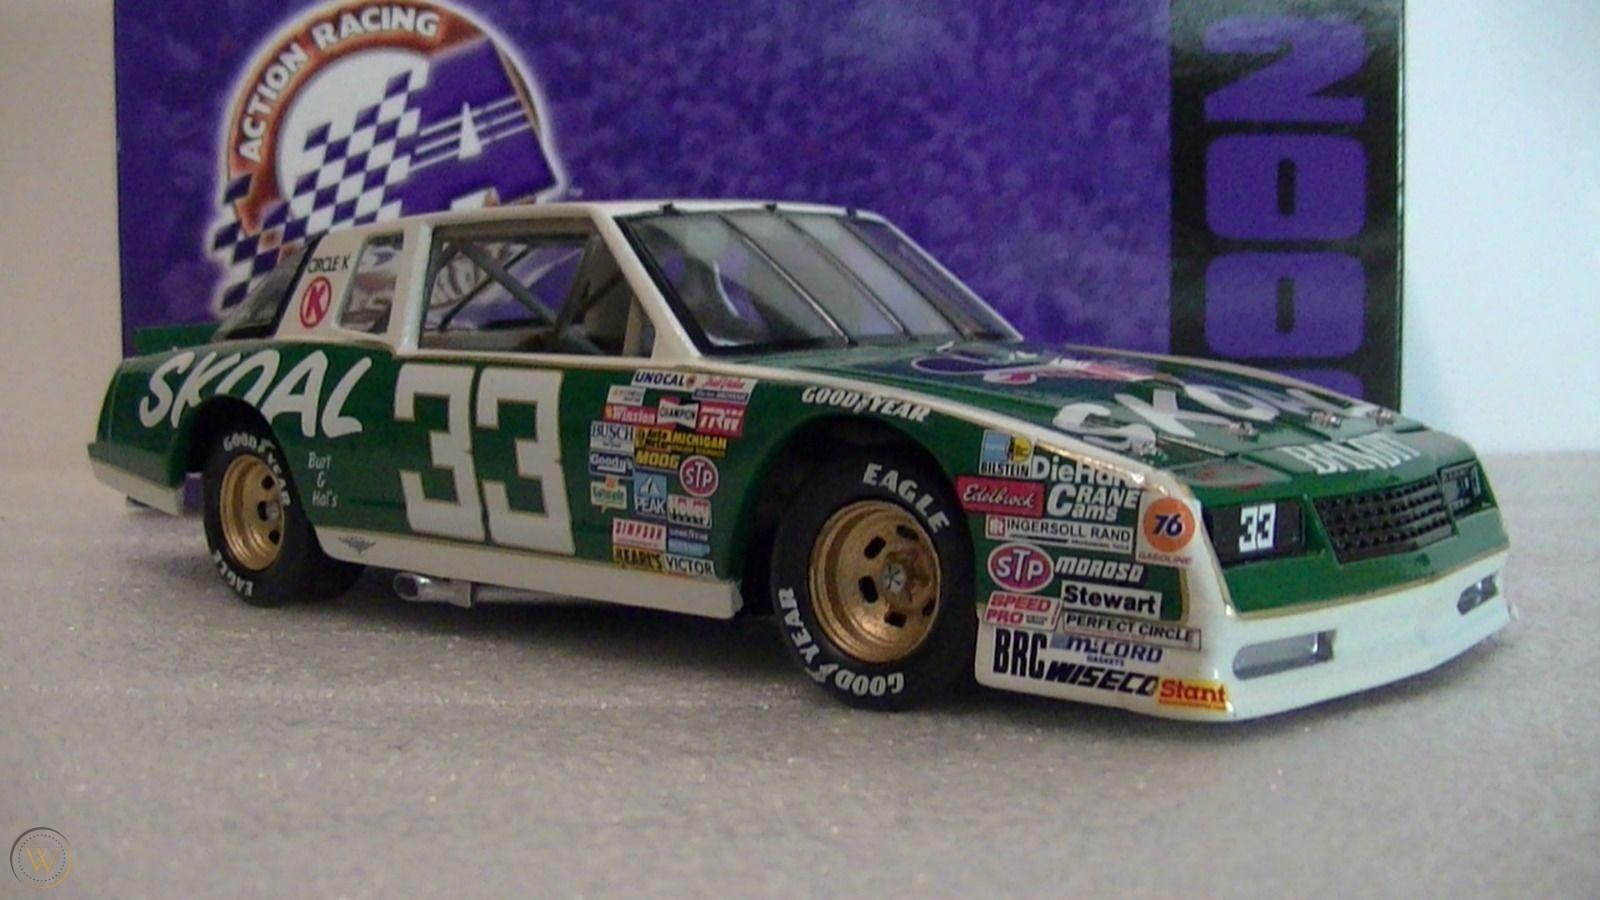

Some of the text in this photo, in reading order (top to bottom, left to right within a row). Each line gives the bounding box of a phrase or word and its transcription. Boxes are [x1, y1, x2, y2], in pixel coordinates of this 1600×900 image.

[239, 6, 440, 163] ACTION RACING
[1204, 16, 1367, 403] 200
[308, 255, 351, 273] CIRCLE K
[634, 371, 685, 387] UNOCAL
[139, 349, 373, 439] SKOAL
[802, 386, 932, 422] GOODYEAR
[592, 422, 635, 441] BUSCH
[672, 432, 728, 450] MICHIGAN
[308, 451, 332, 470] Burt
[394, 363, 576, 555] 33
[635, 450, 681, 470] MOOG
[980, 461, 1031, 479] BILSTEIN
[316, 471, 327, 489] &
[685, 461, 714, 488] STP
[635, 497, 667, 515] PEAK
[862, 462, 951, 534] EAGLE
[963, 483, 1036, 509] Edelbrock
[1006, 517, 1087, 539] INGERSOLL
[1091, 525, 1131, 543] RAND
[1152, 513, 1184, 537] 76
[1238, 504, 1276, 552] 33
[666, 555, 714, 576] VICTOR
[996, 549, 1045, 578] STP
[990, 593, 1052, 613] SPEED
[1064, 585, 1156, 614] Stewart
[986, 608, 1024, 625] PRO
[1066, 613, 1133, 634] PERFECT
[1138, 624, 1192, 643] CIRCLE
[778, 587, 905, 696] GOODYEAR
[1045, 660, 1160, 697] WISECO
[1159, 679, 1226, 702] Stant
